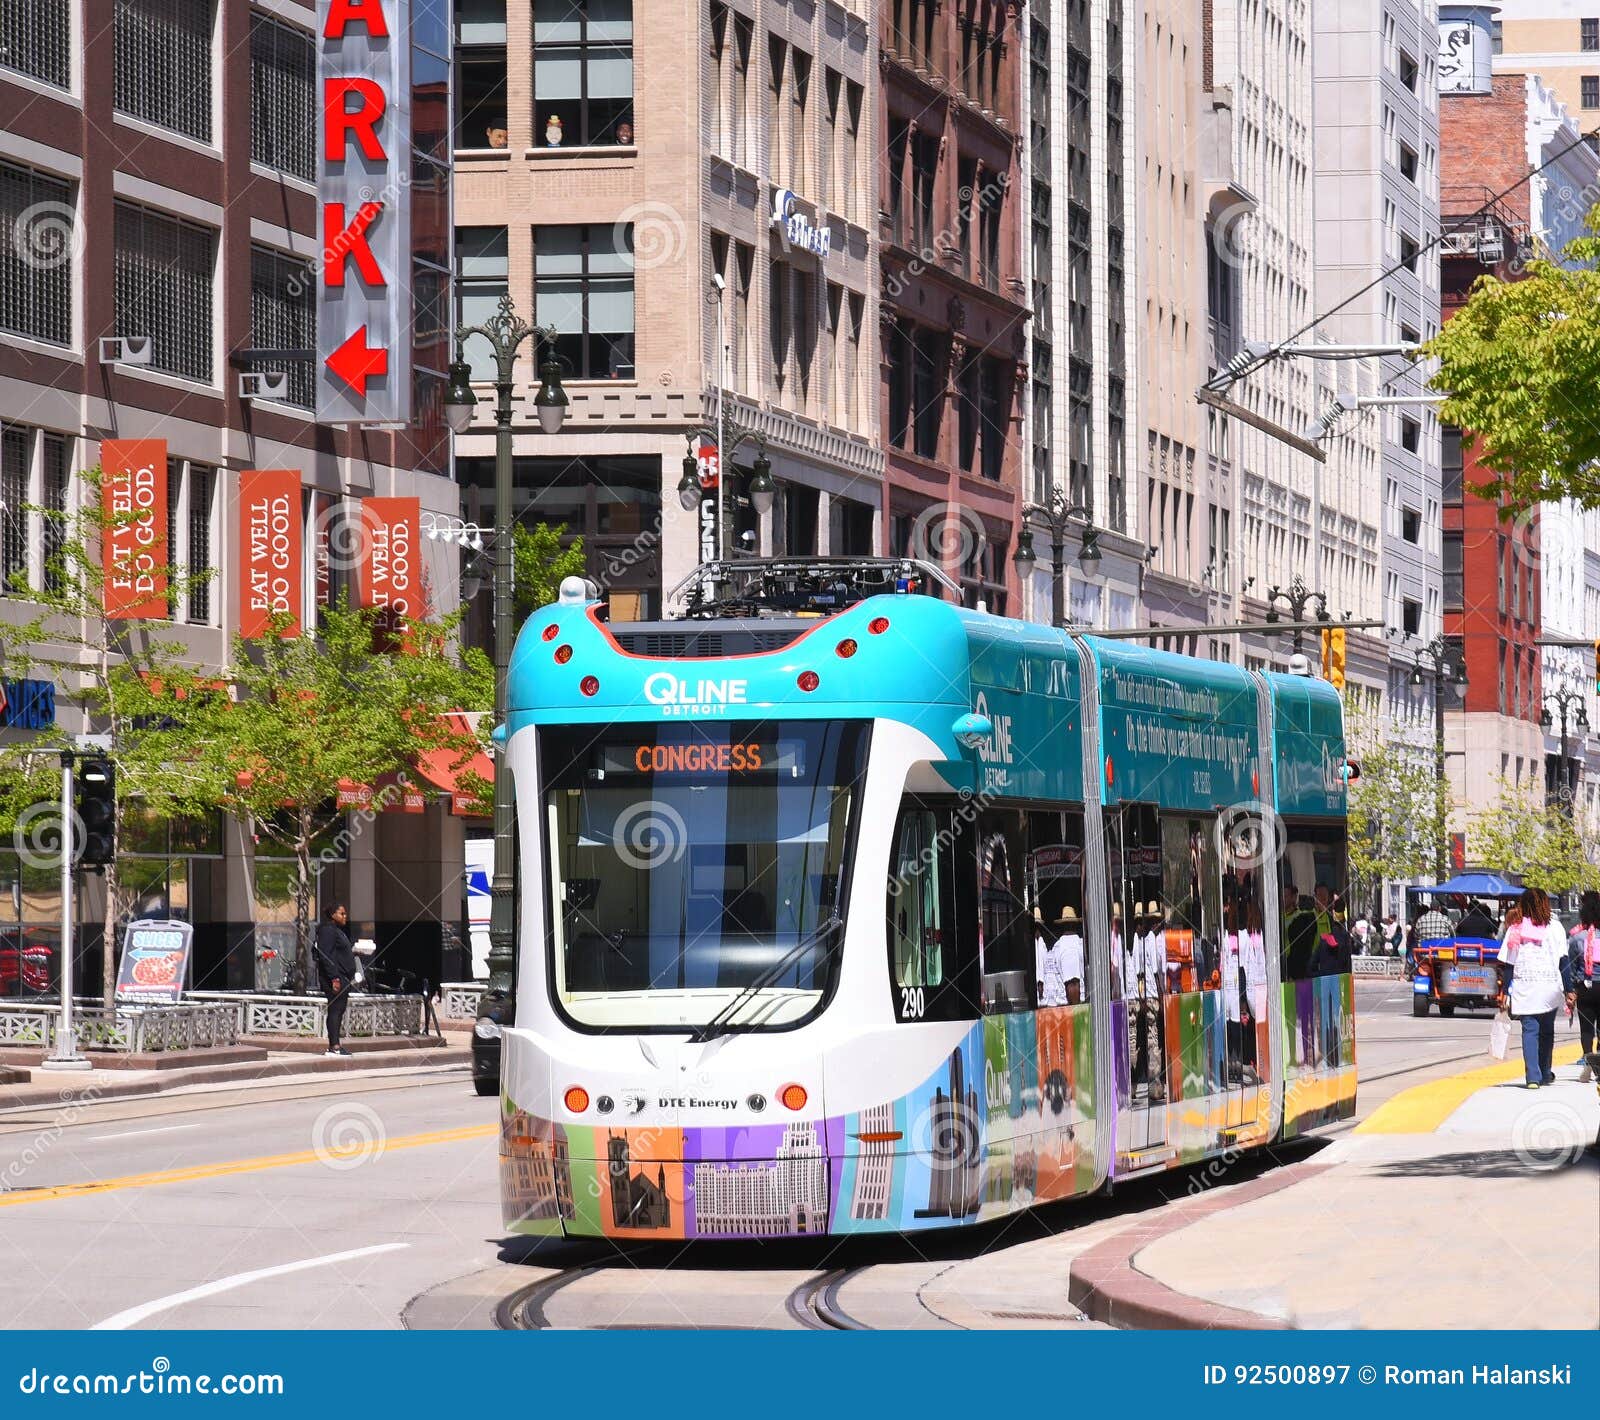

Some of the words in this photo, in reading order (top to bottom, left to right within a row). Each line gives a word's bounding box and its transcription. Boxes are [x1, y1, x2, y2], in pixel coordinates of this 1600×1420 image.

[113, 468, 132, 537] WELL
[136, 464, 155, 545] GOOD.
[251, 498, 269, 563] WELL
[272, 494, 290, 570] GOOD.
[113, 544, 132, 590] EAT
[136, 554, 155, 593] DO
[372, 523, 389, 584] WELL
[392, 519, 410, 590] GOOD.
[251, 569, 268, 611] EAT
[272, 577, 290, 614] DO
[7, 678, 56, 731] SLICES
[644, 672, 748, 704] QLINE
[662, 704, 727, 716] DETROIT
[635, 744, 762, 772] CONGRESS
[901, 987, 925, 1018] 290
[658, 1098, 687, 1108] DTE
[689, 1098, 738, 1110] Energy
